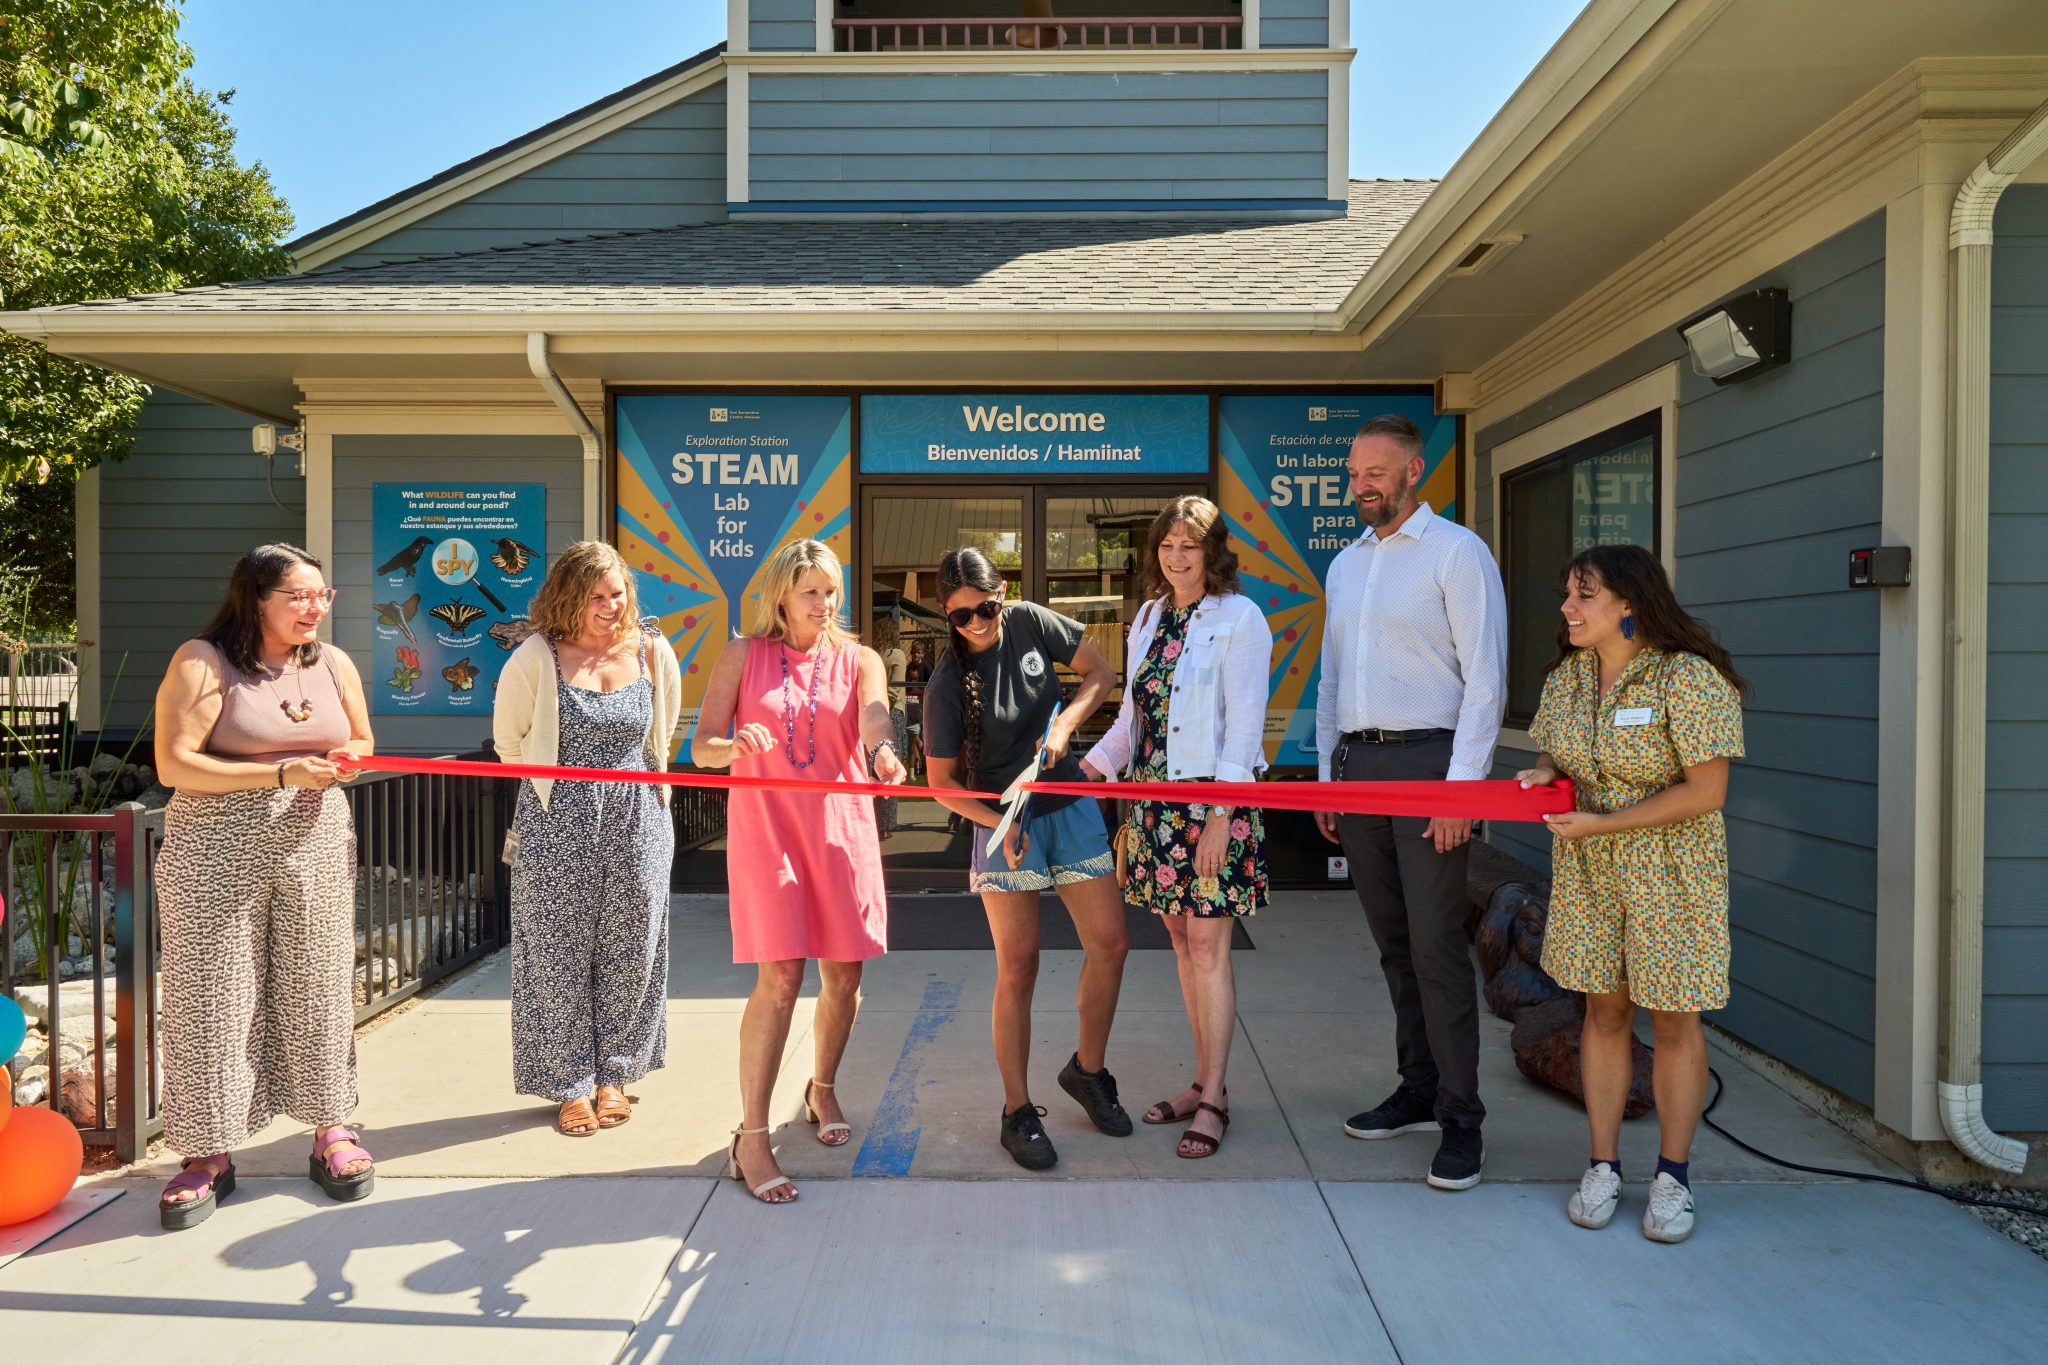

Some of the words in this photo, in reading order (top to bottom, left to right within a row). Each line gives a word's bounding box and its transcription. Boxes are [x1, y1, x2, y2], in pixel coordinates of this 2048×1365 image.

[963, 405, 1106, 432] Welcome
[686, 435, 747, 448] Exploration
[750, 436, 788, 446] Station
[1270, 434, 1316, 445] Estación
[1319, 434, 1332, 445] de
[928, 445, 1039, 461] Bienvenidos
[1043, 445, 1052, 461] /
[1058, 444, 1142, 461] Hamiinat
[1276, 454, 1298, 467] Un
[671, 453, 798, 485] STEAM
[482, 501, 509, 510] pond?
[714, 493, 750, 511] Lab
[717, 516, 747, 534] for
[1313, 516, 1356, 532] para
[452, 544, 457, 560] I
[710, 539, 754, 558] Kids
[437, 559, 474, 575] SPY
